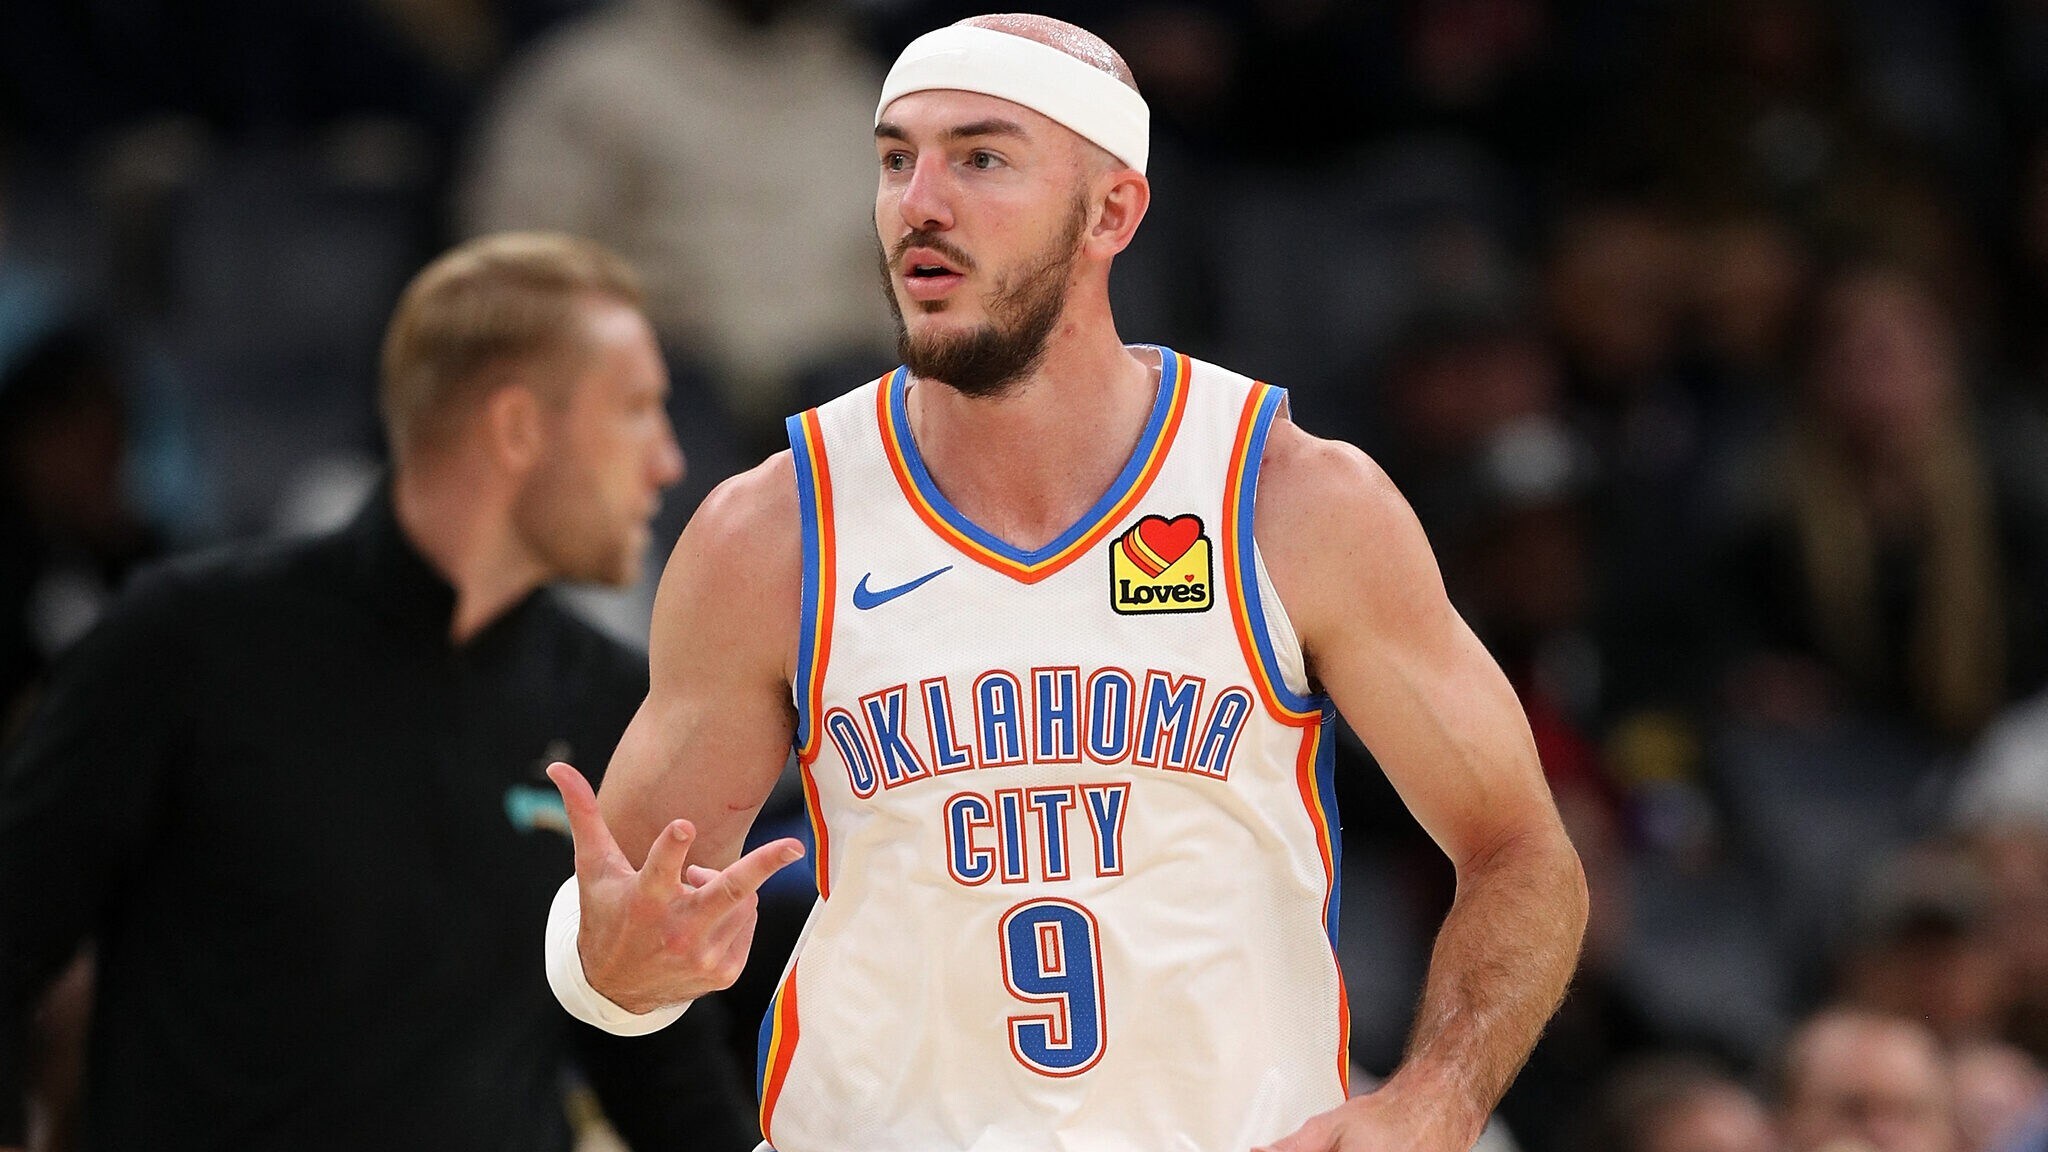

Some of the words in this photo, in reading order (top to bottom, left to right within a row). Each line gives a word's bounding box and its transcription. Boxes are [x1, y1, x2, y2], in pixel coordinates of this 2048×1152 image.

[823, 666, 1254, 799] OKLAHOMA
[943, 782, 1131, 886] CITY
[998, 897, 1107, 1078] 9
